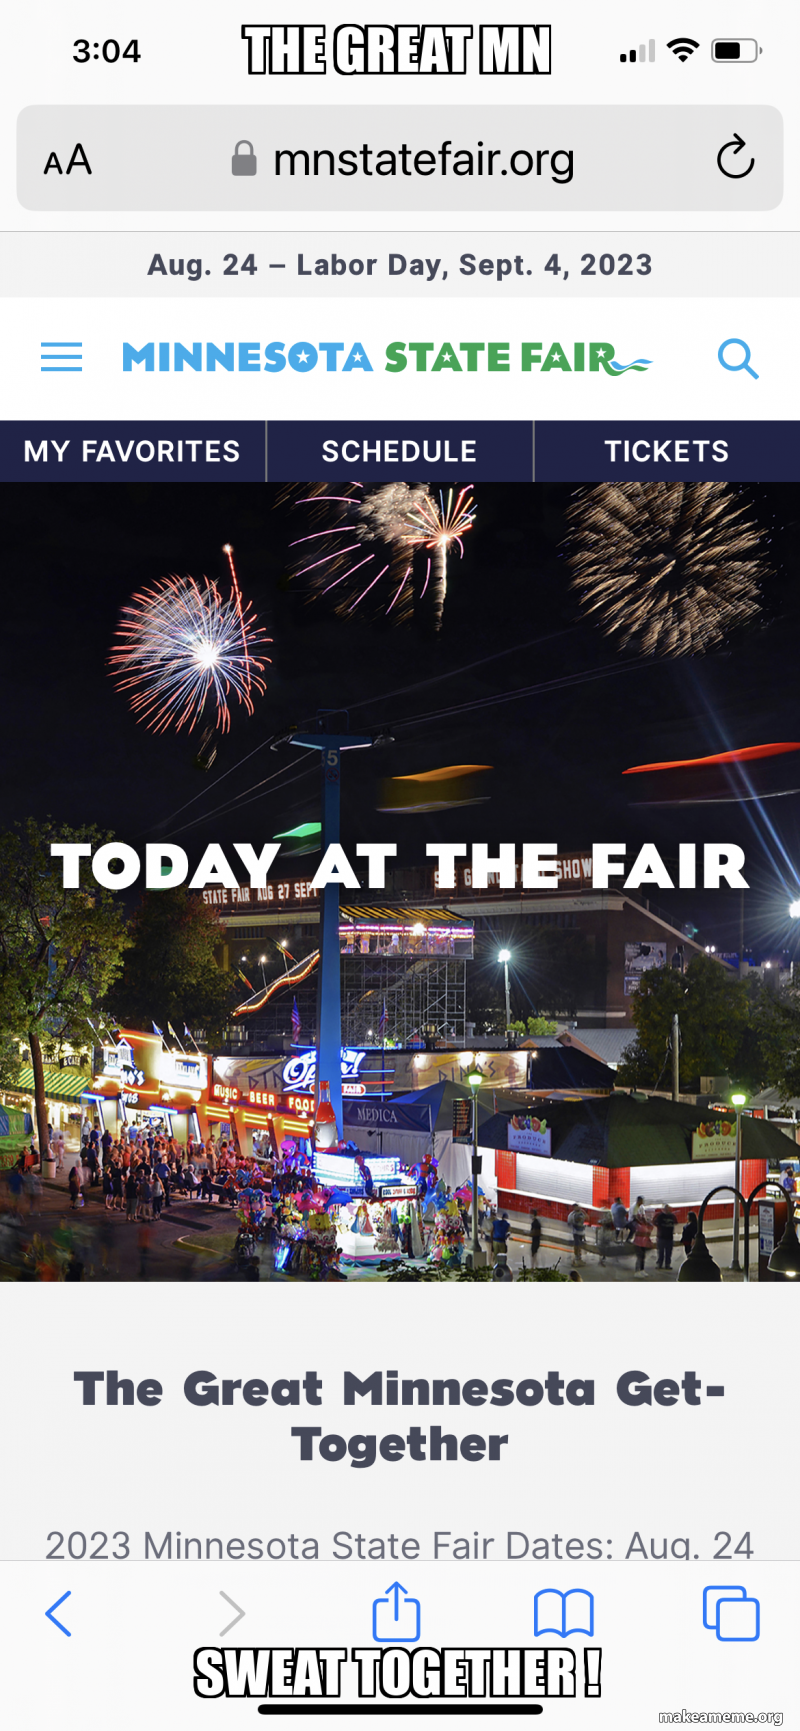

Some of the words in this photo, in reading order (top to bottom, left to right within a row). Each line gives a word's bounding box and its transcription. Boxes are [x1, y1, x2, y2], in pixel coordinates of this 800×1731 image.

[73, 39, 141, 63] 3:04
[275, 141, 573, 184] mnstatefair.org
[147, 254, 211, 281] Aug.
[223, 253, 257, 275] 24
[298, 254, 377, 275] Labor
[389, 254, 447, 281] Day,
[459, 253, 532, 281] Sept.
[544, 254, 569, 280] 4,
[581, 253, 651, 275] 2023
[123, 342, 374, 373] MINNESOTA
[385, 342, 510, 373] STATE
[522, 342, 625, 376] FAIR
[25, 440, 70, 462] MY
[83, 440, 239, 462] FAVORITES
[322, 440, 476, 462] SCHEDULE
[604, 440, 728, 462] TICKETS
[327, 750, 338, 766] 5
[51, 843, 282, 889] TODAY
[308, 843, 397, 888] AT
[426, 843, 558, 888] THE
[592, 843, 749, 888] FAIR
[203, 890, 228, 904] STATE
[231, 887, 250, 902] FAIR
[257, 885, 273, 900] AUG
[278, 884, 289, 899] 27
[294, 882, 318, 898] SEPT
[213, 1084, 237, 1100] MUSIC
[249, 1091, 275, 1106] BEER
[357, 1108, 397, 1123] MEDICA
[74, 1370, 163, 1406] The
[184, 1370, 322, 1406] Great
[344, 1370, 594, 1406] Minnesota
[616, 1370, 724, 1406] Get-
[291, 1426, 508, 1468] Together
[46, 1531, 130, 1560] 2023
[145, 1531, 318, 1560] Minnesota
[333, 1531, 420, 1560] State
[434, 1531, 495, 1560] Fair
[508, 1531, 612, 1560] Dates:
[625, 1532, 699, 1560] Aug.
[713, 1531, 754, 1560] 24
